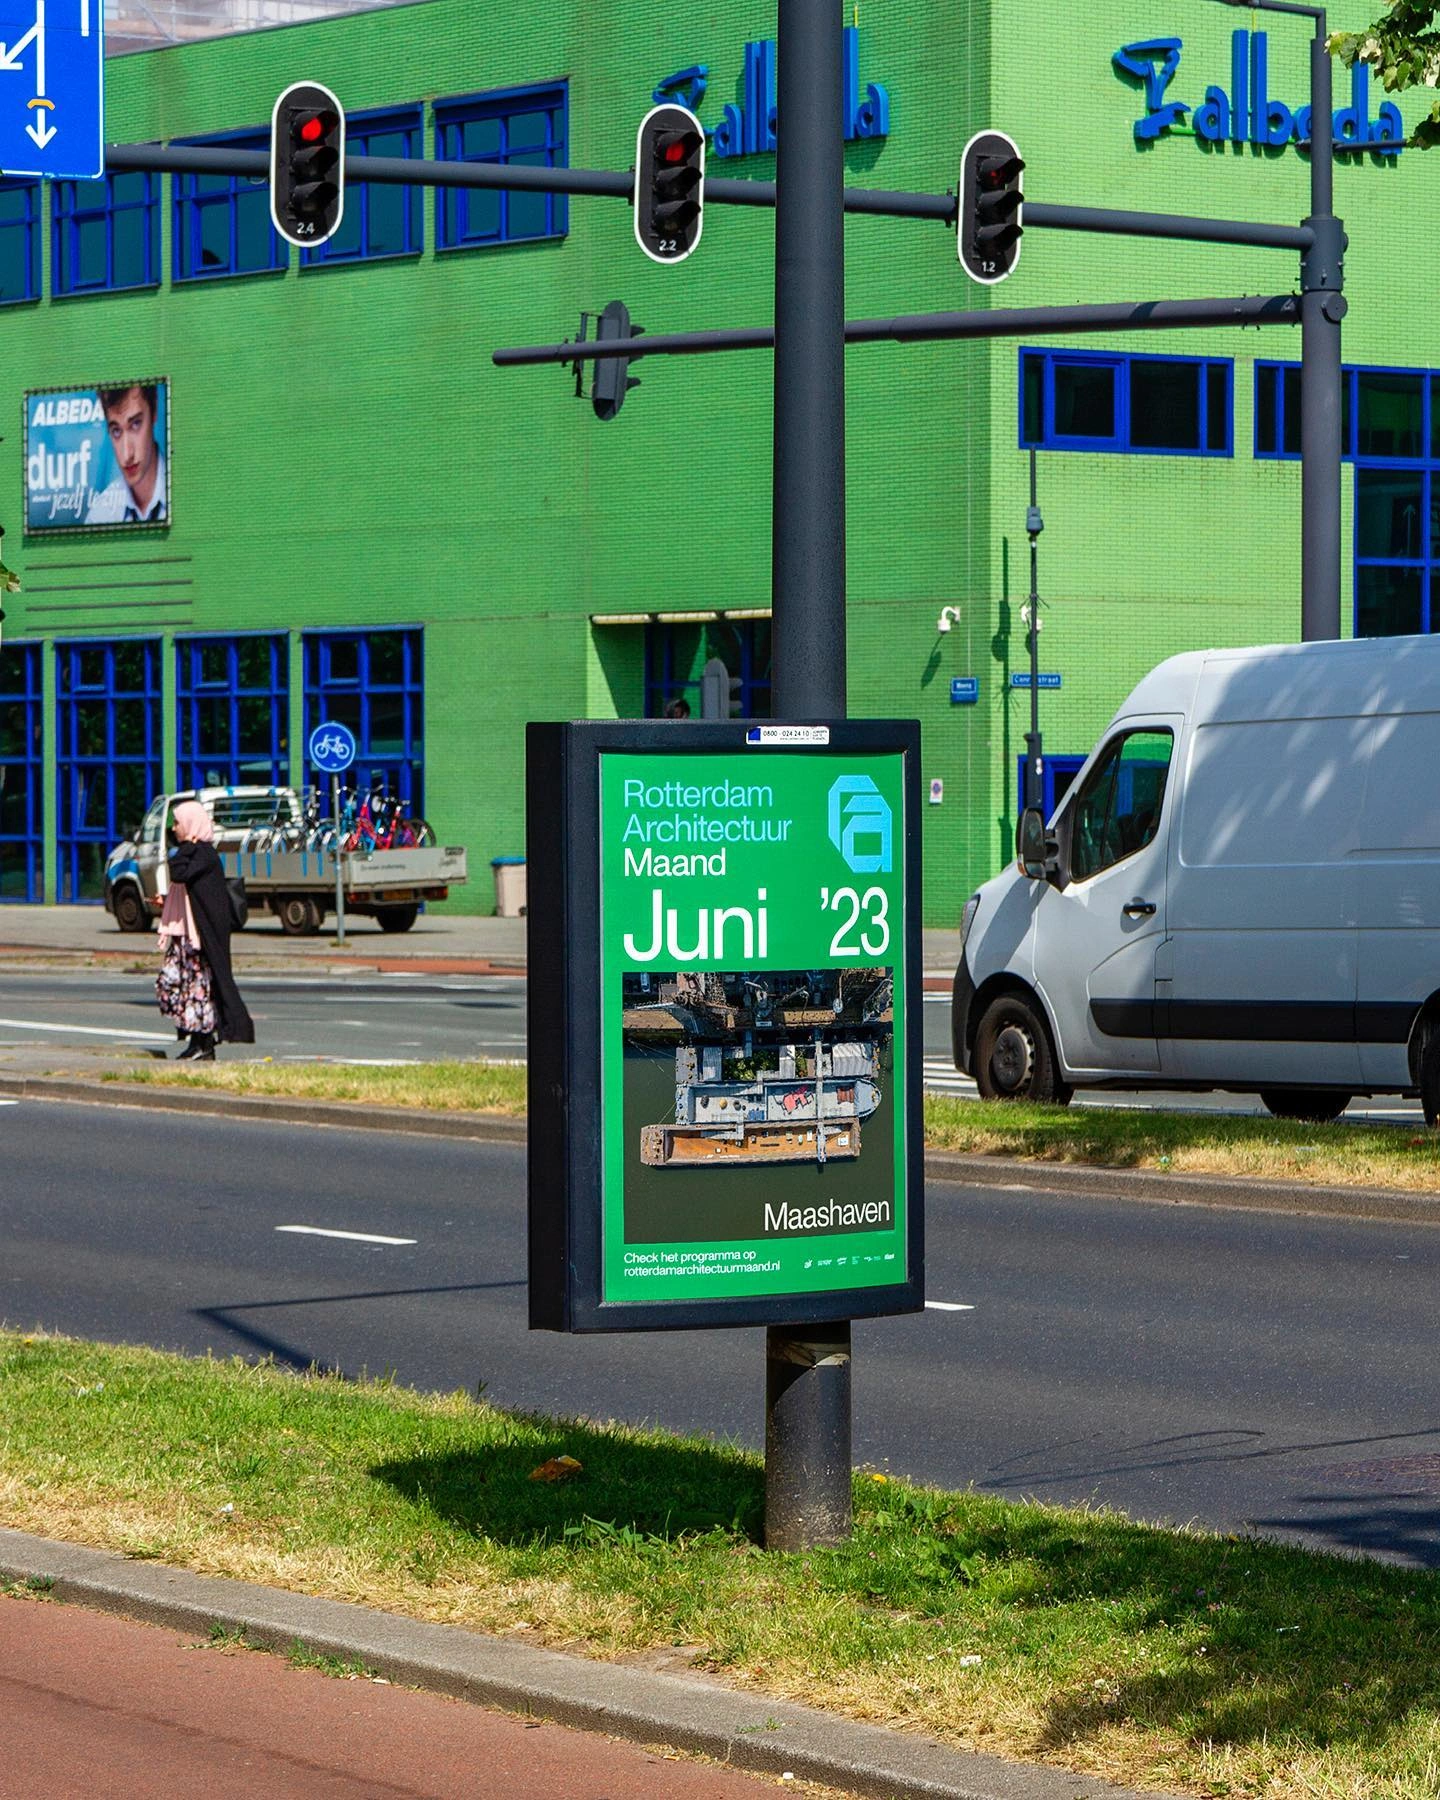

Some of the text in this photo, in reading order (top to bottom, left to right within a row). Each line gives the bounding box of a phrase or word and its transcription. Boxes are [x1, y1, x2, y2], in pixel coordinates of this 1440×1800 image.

[296, 222, 315, 235] 2.4
[659, 239, 677, 252] 2.2
[982, 261, 996, 273] 1.2
[31, 397, 105, 427] ALBEDA
[28, 439, 92, 491] durf
[624, 779, 773, 808] Rotterdam
[622, 812, 793, 842] Architectuur
[624, 847, 727, 877] Maand
[623, 887, 768, 962] Juni
[764, 1199, 890, 1231] Maashaven
[624, 1250, 756, 1264] Check het programma op
[624, 1260, 780, 1277] rotterdamarchitectuurmaand.nl
